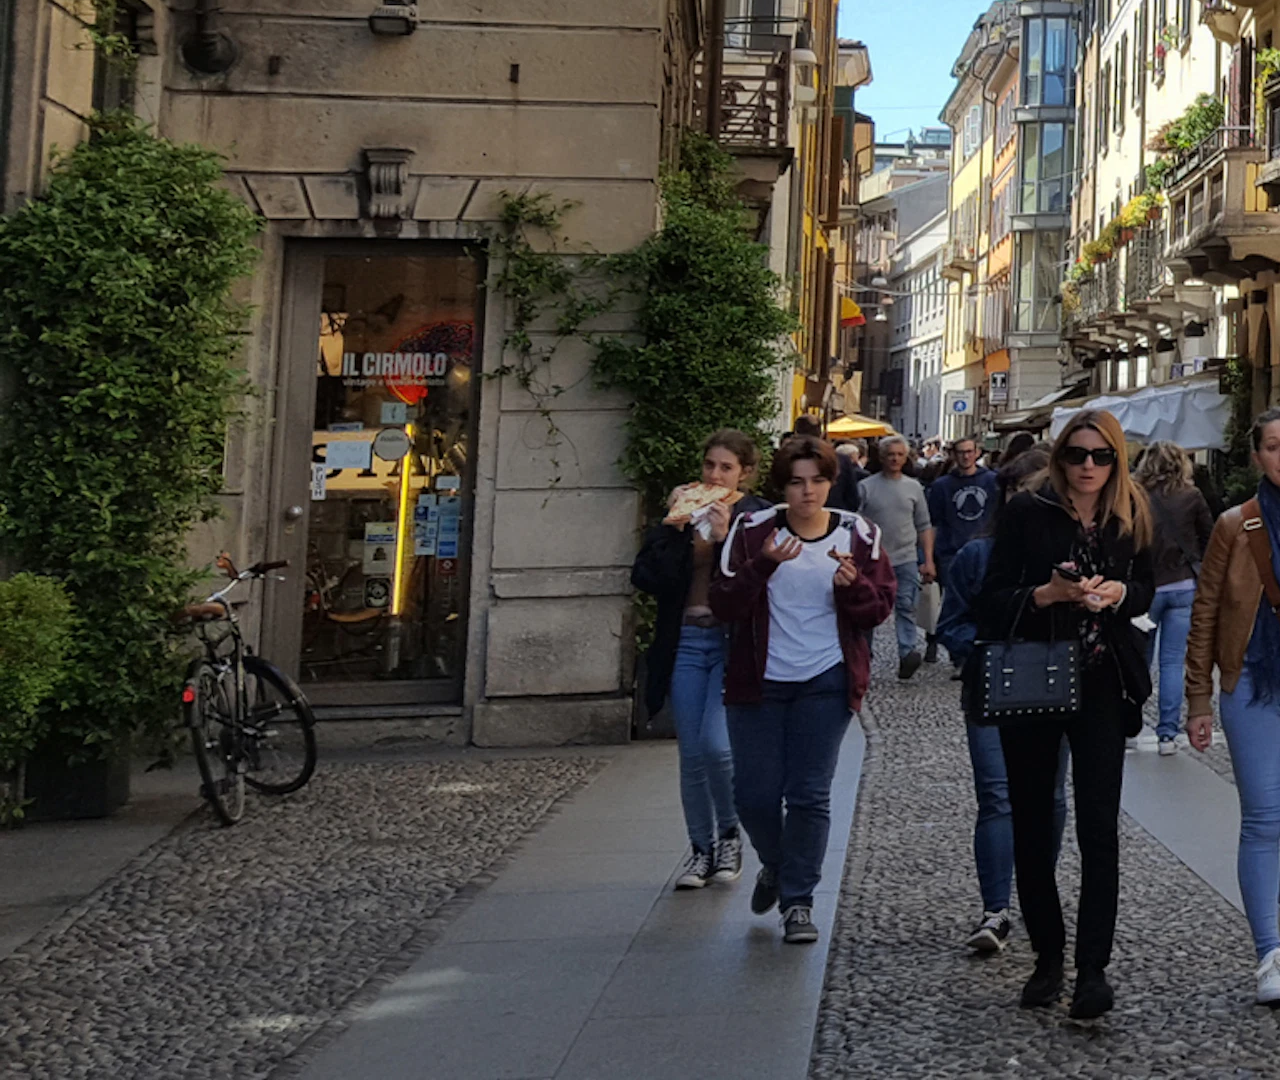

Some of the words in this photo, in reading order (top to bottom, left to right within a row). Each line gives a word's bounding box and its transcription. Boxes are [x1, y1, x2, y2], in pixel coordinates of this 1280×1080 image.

[342, 352, 358, 377] IL
[361, 351, 448, 377] CIRMOLO
[313, 466, 324, 497] PUSH
